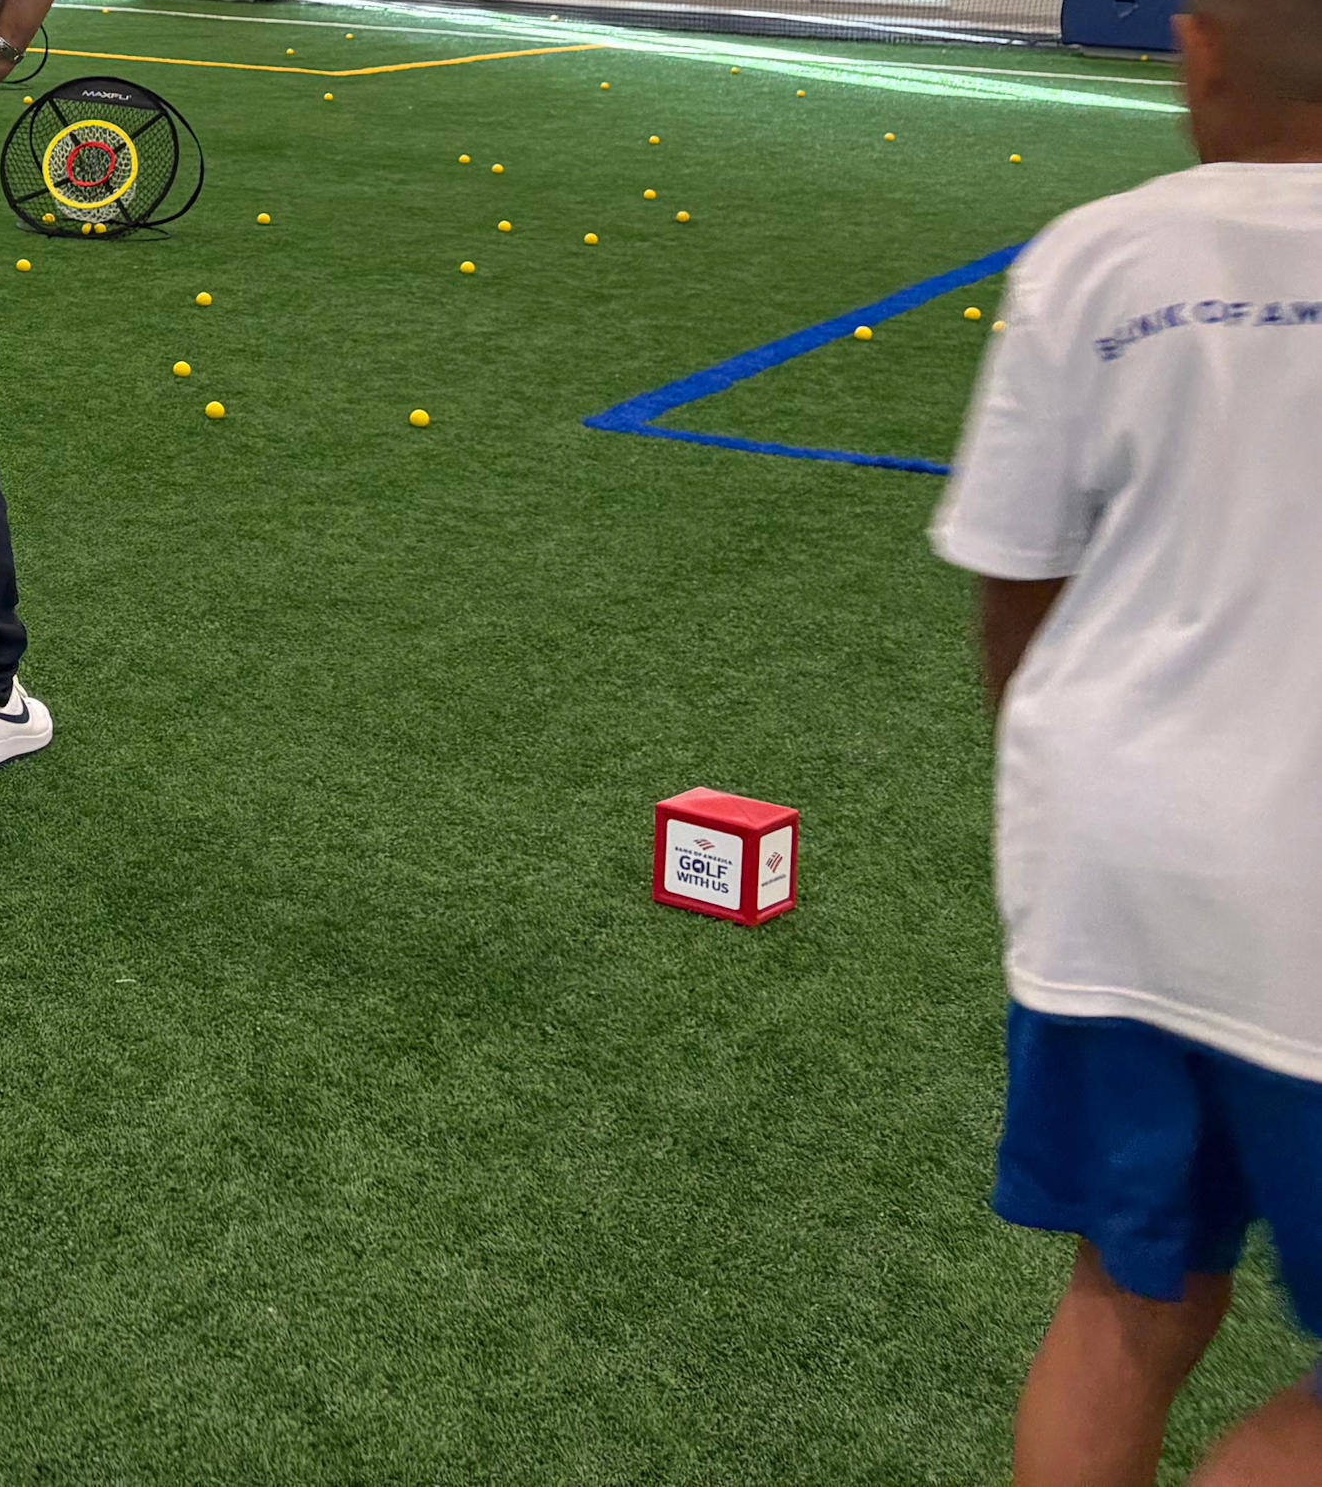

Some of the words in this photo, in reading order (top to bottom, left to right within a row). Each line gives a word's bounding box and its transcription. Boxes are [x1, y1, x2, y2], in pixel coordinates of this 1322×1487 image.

[679, 855, 729, 880] GOLF
[677, 870, 710, 889] WITH
[711, 879, 730, 894] US
